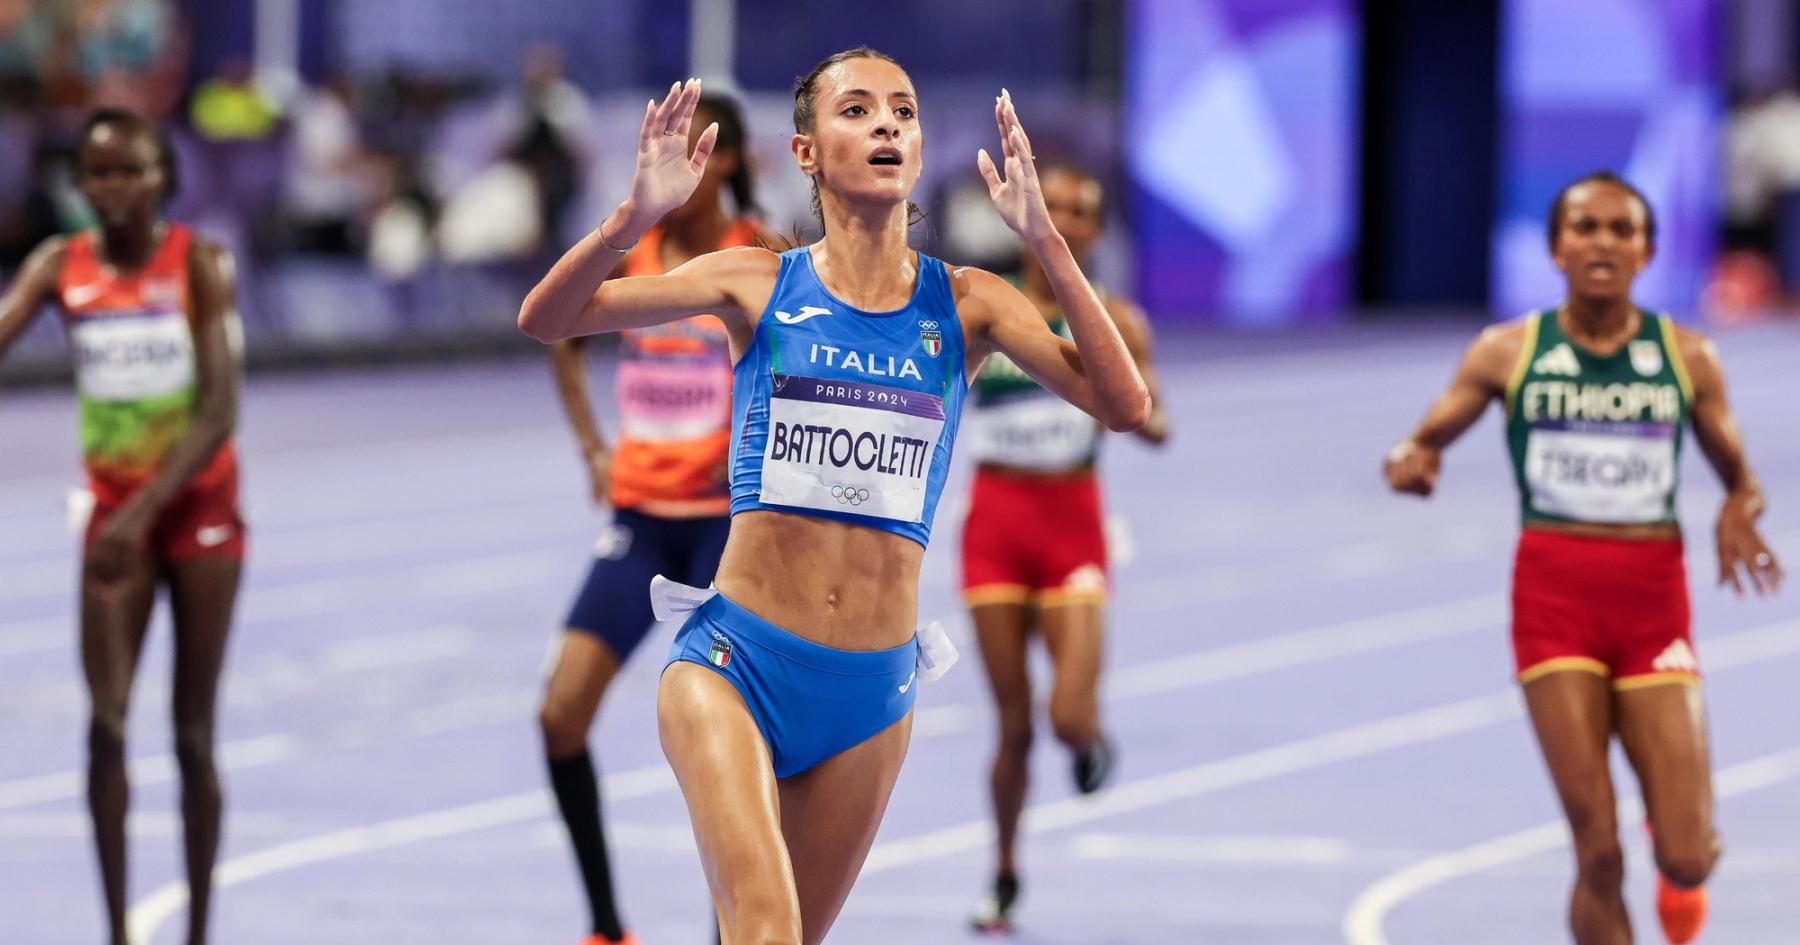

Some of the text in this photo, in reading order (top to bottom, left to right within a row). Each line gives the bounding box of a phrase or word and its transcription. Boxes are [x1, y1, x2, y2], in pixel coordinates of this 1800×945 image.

[810, 344, 922, 381] ITALIA
[816, 385, 907, 407] PARIS 2024
[1523, 381, 1679, 422] ETHIOPIA
[771, 422, 928, 478] BATTOCLETTI
